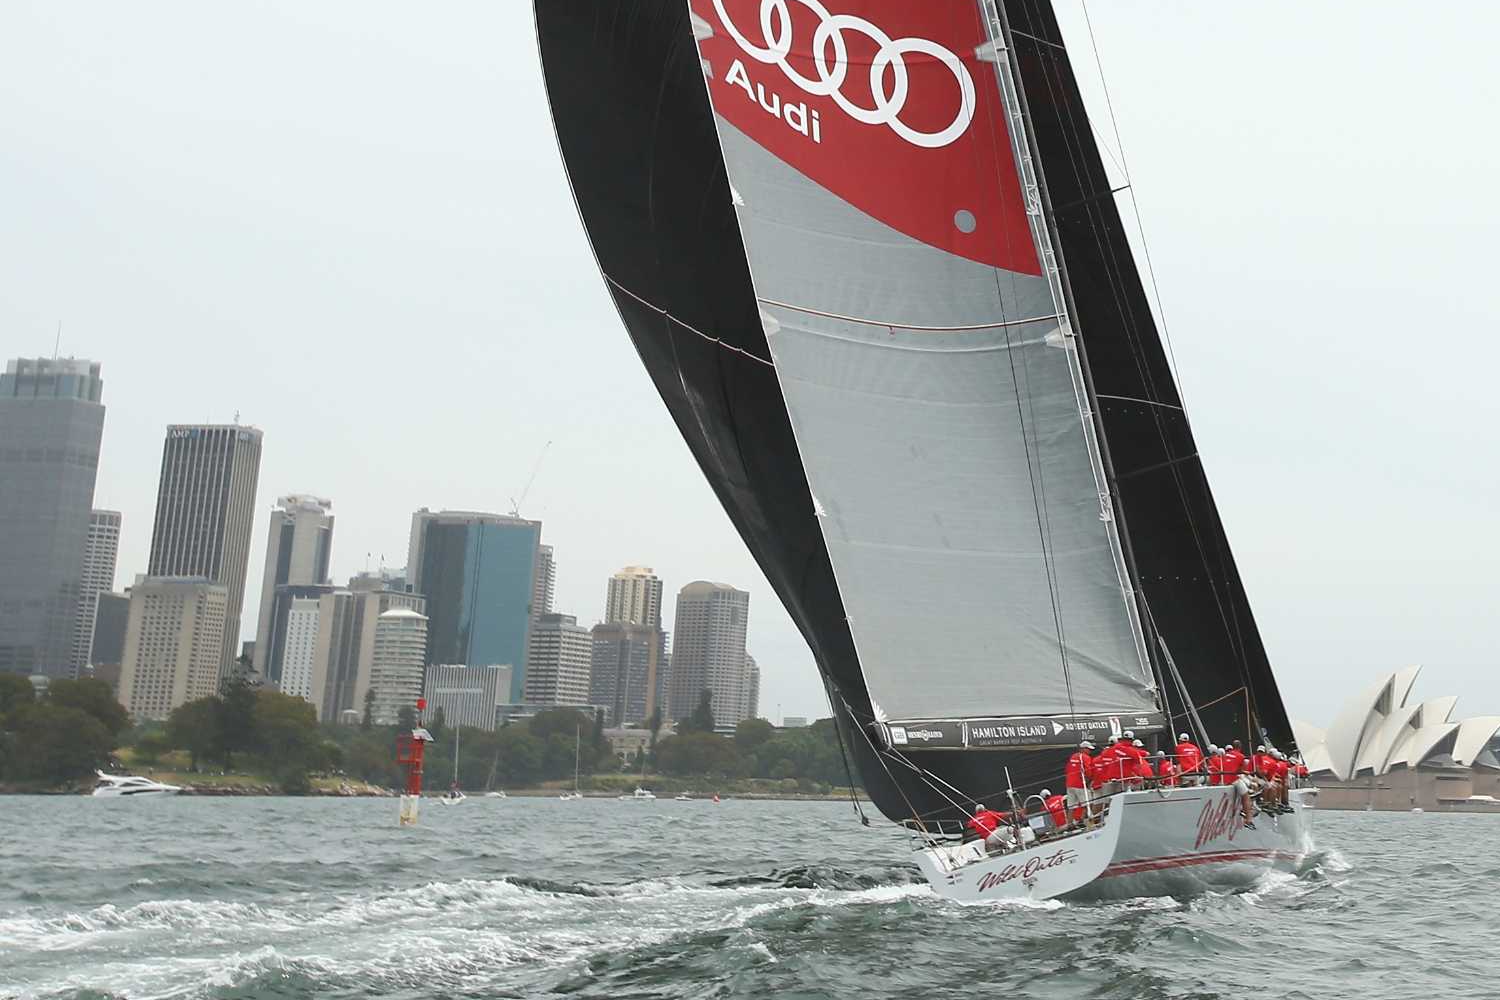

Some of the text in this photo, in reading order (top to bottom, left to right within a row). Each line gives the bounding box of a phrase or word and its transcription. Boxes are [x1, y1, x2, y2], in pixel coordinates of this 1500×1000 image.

[725, 59, 822, 143] Audi
[971, 724, 1047, 739] HAMILTON ISLAND
[976, 864, 1024, 892] Wild
[1023, 849, 1079, 878] Oats
